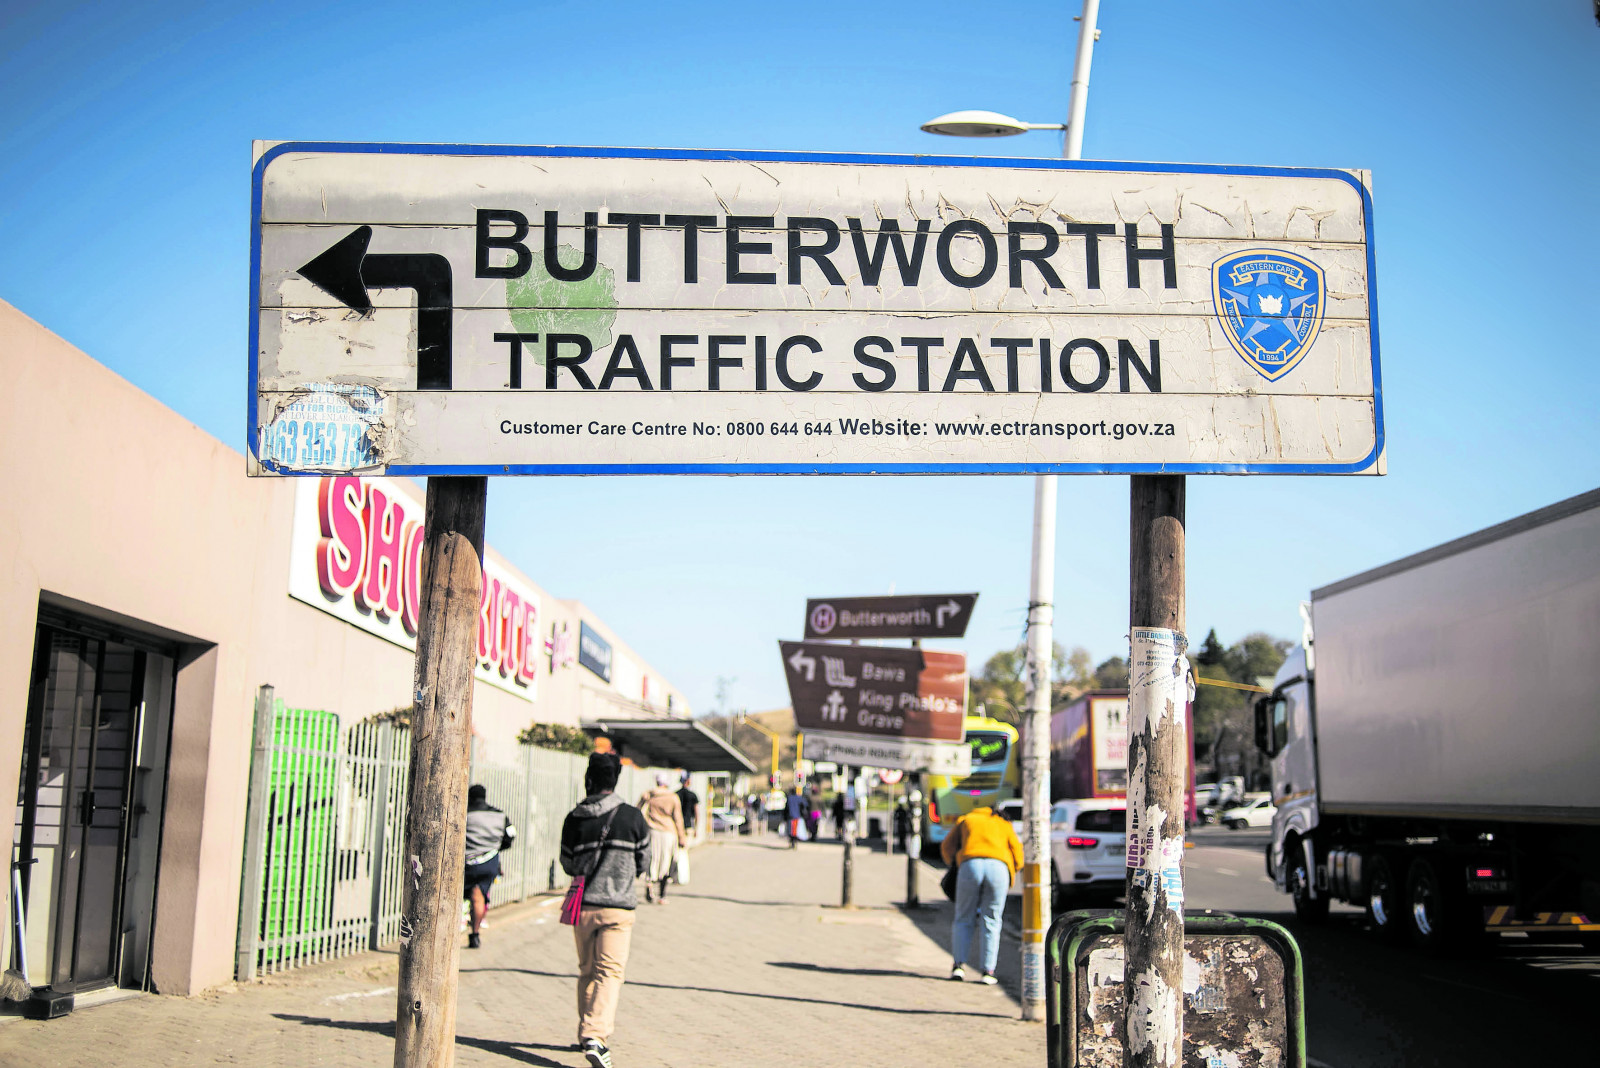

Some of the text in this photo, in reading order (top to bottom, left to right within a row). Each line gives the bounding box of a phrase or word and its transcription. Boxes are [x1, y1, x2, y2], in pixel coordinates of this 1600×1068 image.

[475, 209, 1177, 289] BUTTERWORTH
[1240, 262, 1296, 276] EASTERN CAPE
[1299, 309, 1312, 337] CONTROL
[494, 333, 1162, 393] TRAFFIC STATION
[290, 411, 317, 421] LOVER
[307, 404, 324, 413] FOR
[500, 418, 1175, 440] Customer Care Centre No: 0800 644 644 Website: www.ectransport.gov.za
[302, 421, 337, 466] 353
[839, 609, 931, 627] Butterworth
[862, 662, 906, 682] Bawa
[858, 690, 958, 713] King Phalo's
[857, 710, 904, 729] Grave
